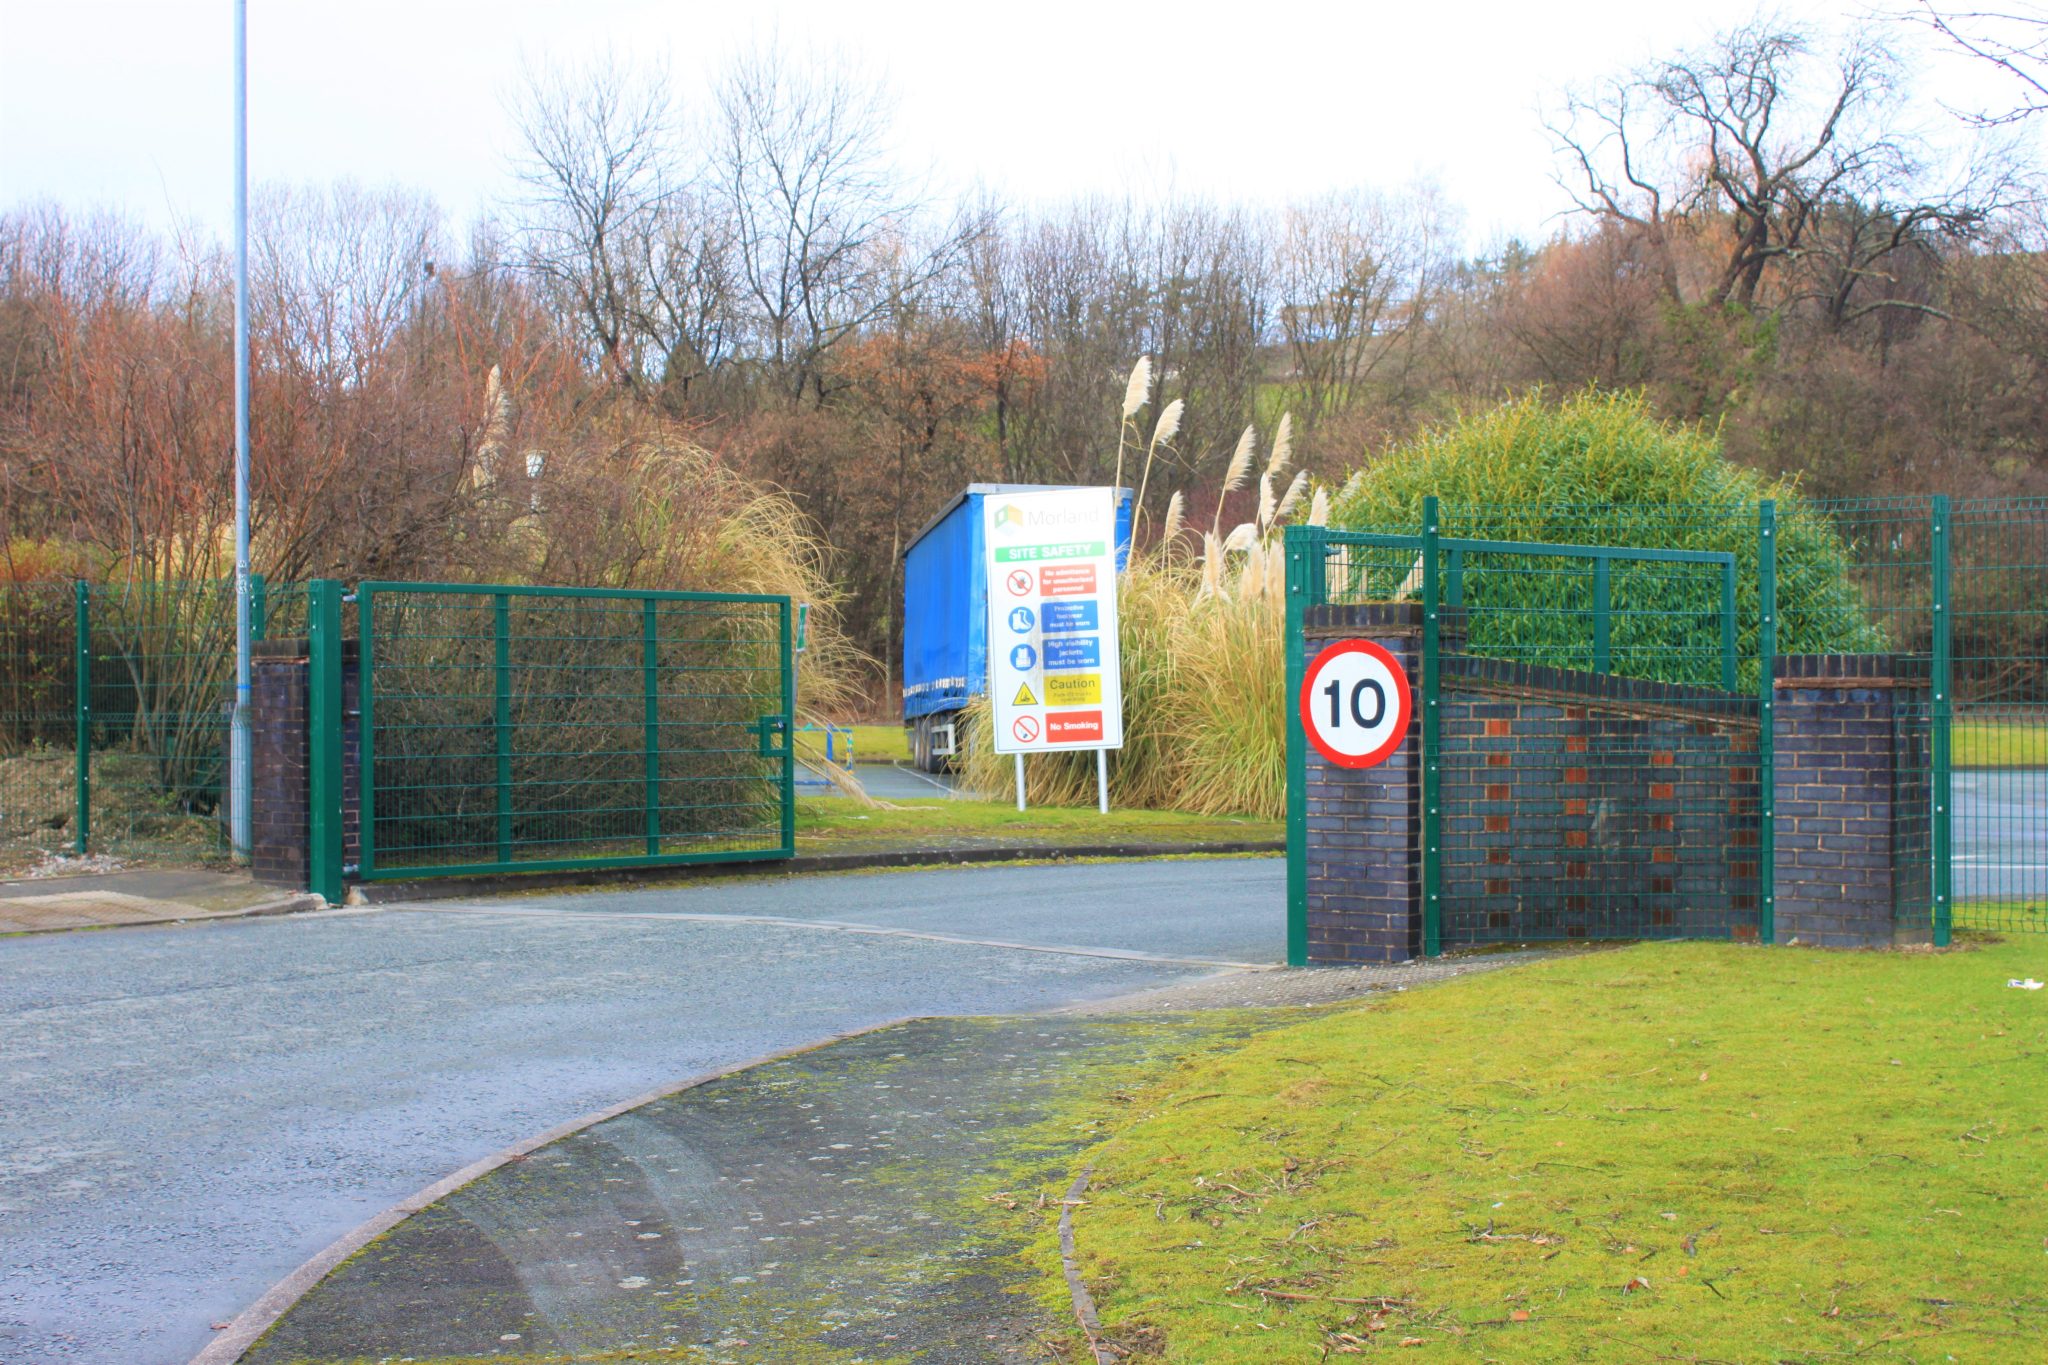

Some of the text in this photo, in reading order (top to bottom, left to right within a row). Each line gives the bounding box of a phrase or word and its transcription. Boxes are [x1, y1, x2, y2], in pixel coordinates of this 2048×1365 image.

[1028, 505, 1098, 525] Morland
[1008, 544, 1092, 560] SITE SAFETY
[1047, 639, 1093, 649] High visibility
[1050, 679, 1095, 689] Caution
[1324, 678, 1386, 729] 10
[1050, 720, 1099, 731] No Smoking
